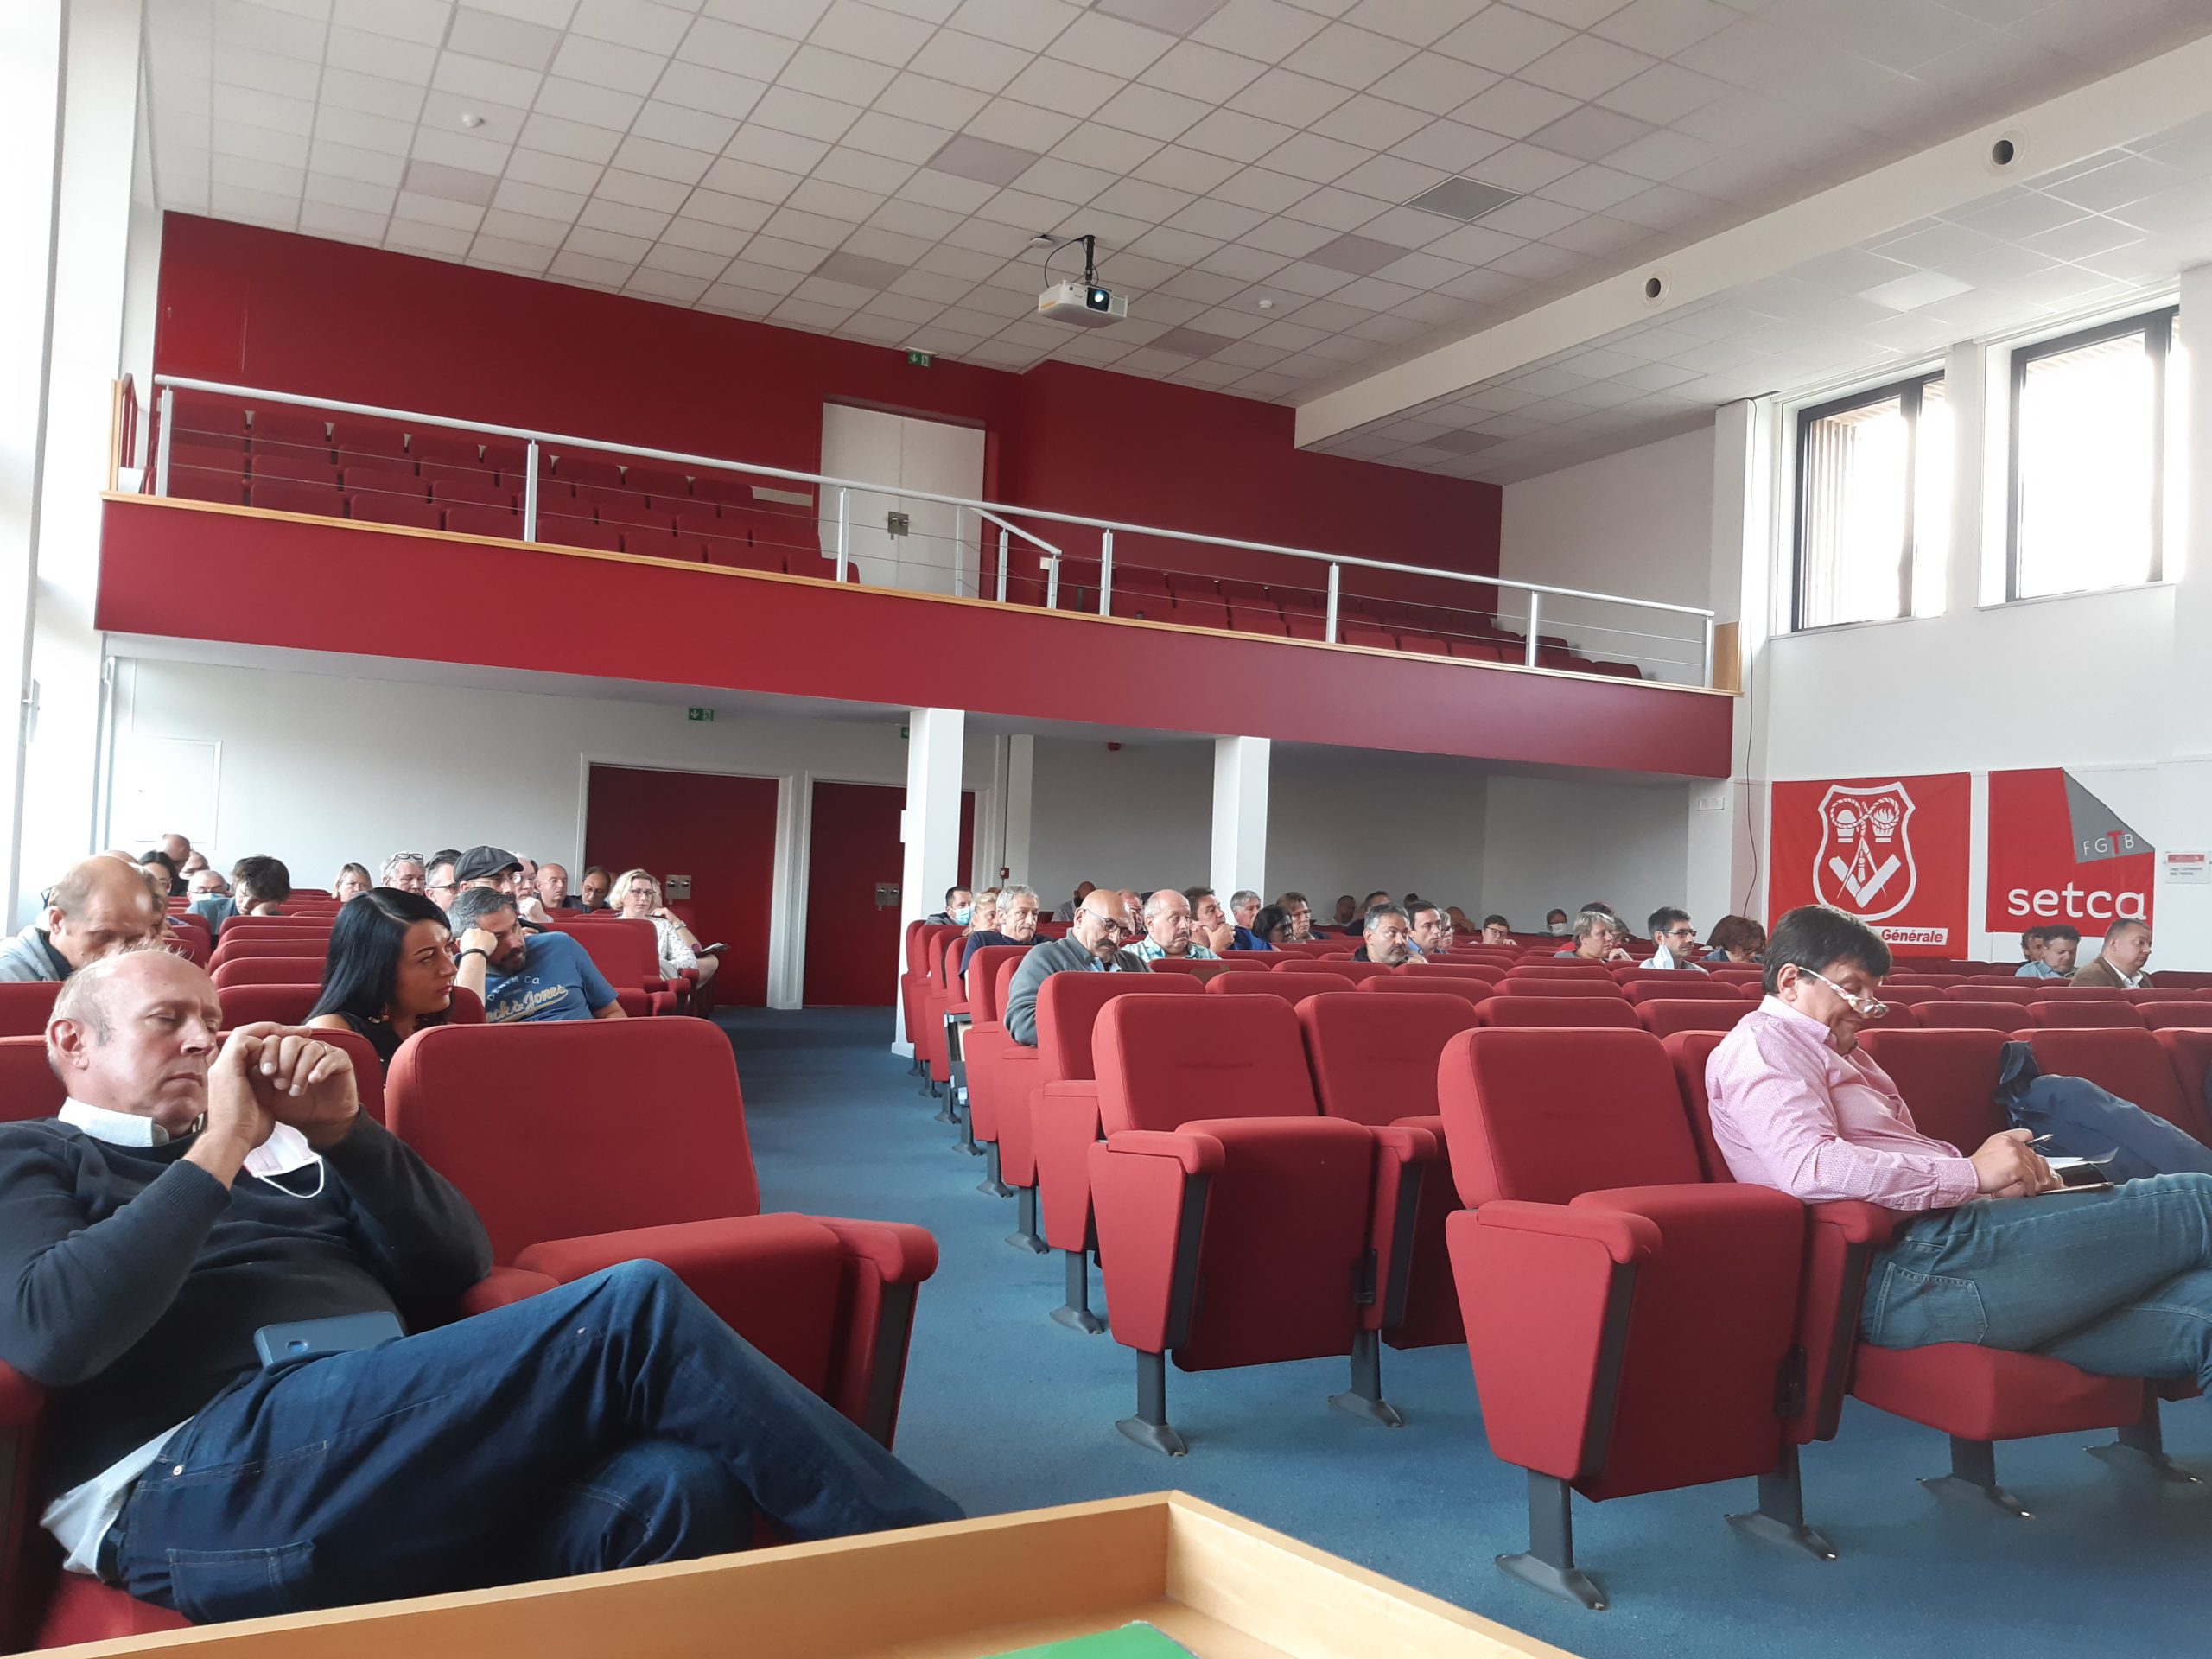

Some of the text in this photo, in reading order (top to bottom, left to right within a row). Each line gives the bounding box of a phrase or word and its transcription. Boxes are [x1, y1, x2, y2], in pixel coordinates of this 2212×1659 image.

[2083, 830, 2134, 856] FGTB
[2007, 881, 2147, 920] setca
[1881, 929, 1943, 943] Générale
